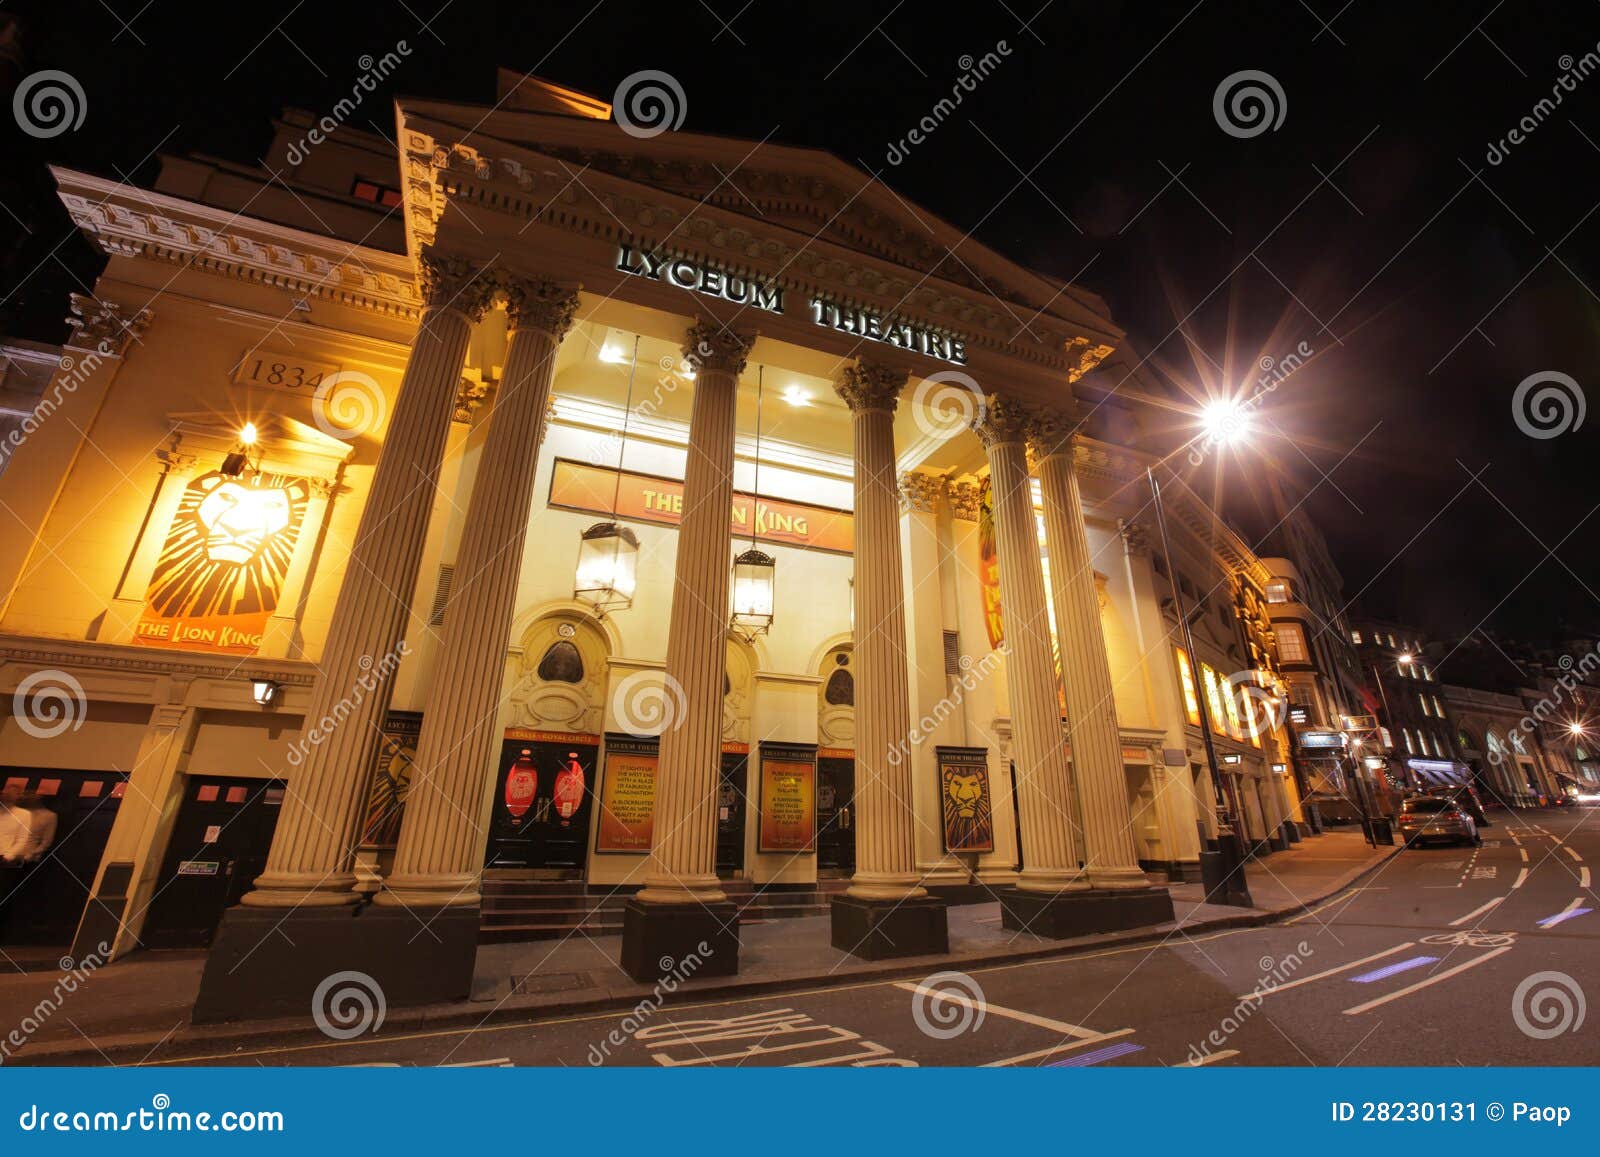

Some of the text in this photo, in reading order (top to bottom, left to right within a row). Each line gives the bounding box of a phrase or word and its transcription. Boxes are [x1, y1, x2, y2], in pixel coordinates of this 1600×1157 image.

[616, 247, 967, 365] LYCEUM THEATRE
[253, 360, 324, 394] 1834
[643, 489, 683, 514] THE
[755, 502, 809, 535] KING
[138, 622, 264, 647] THE LION KING
